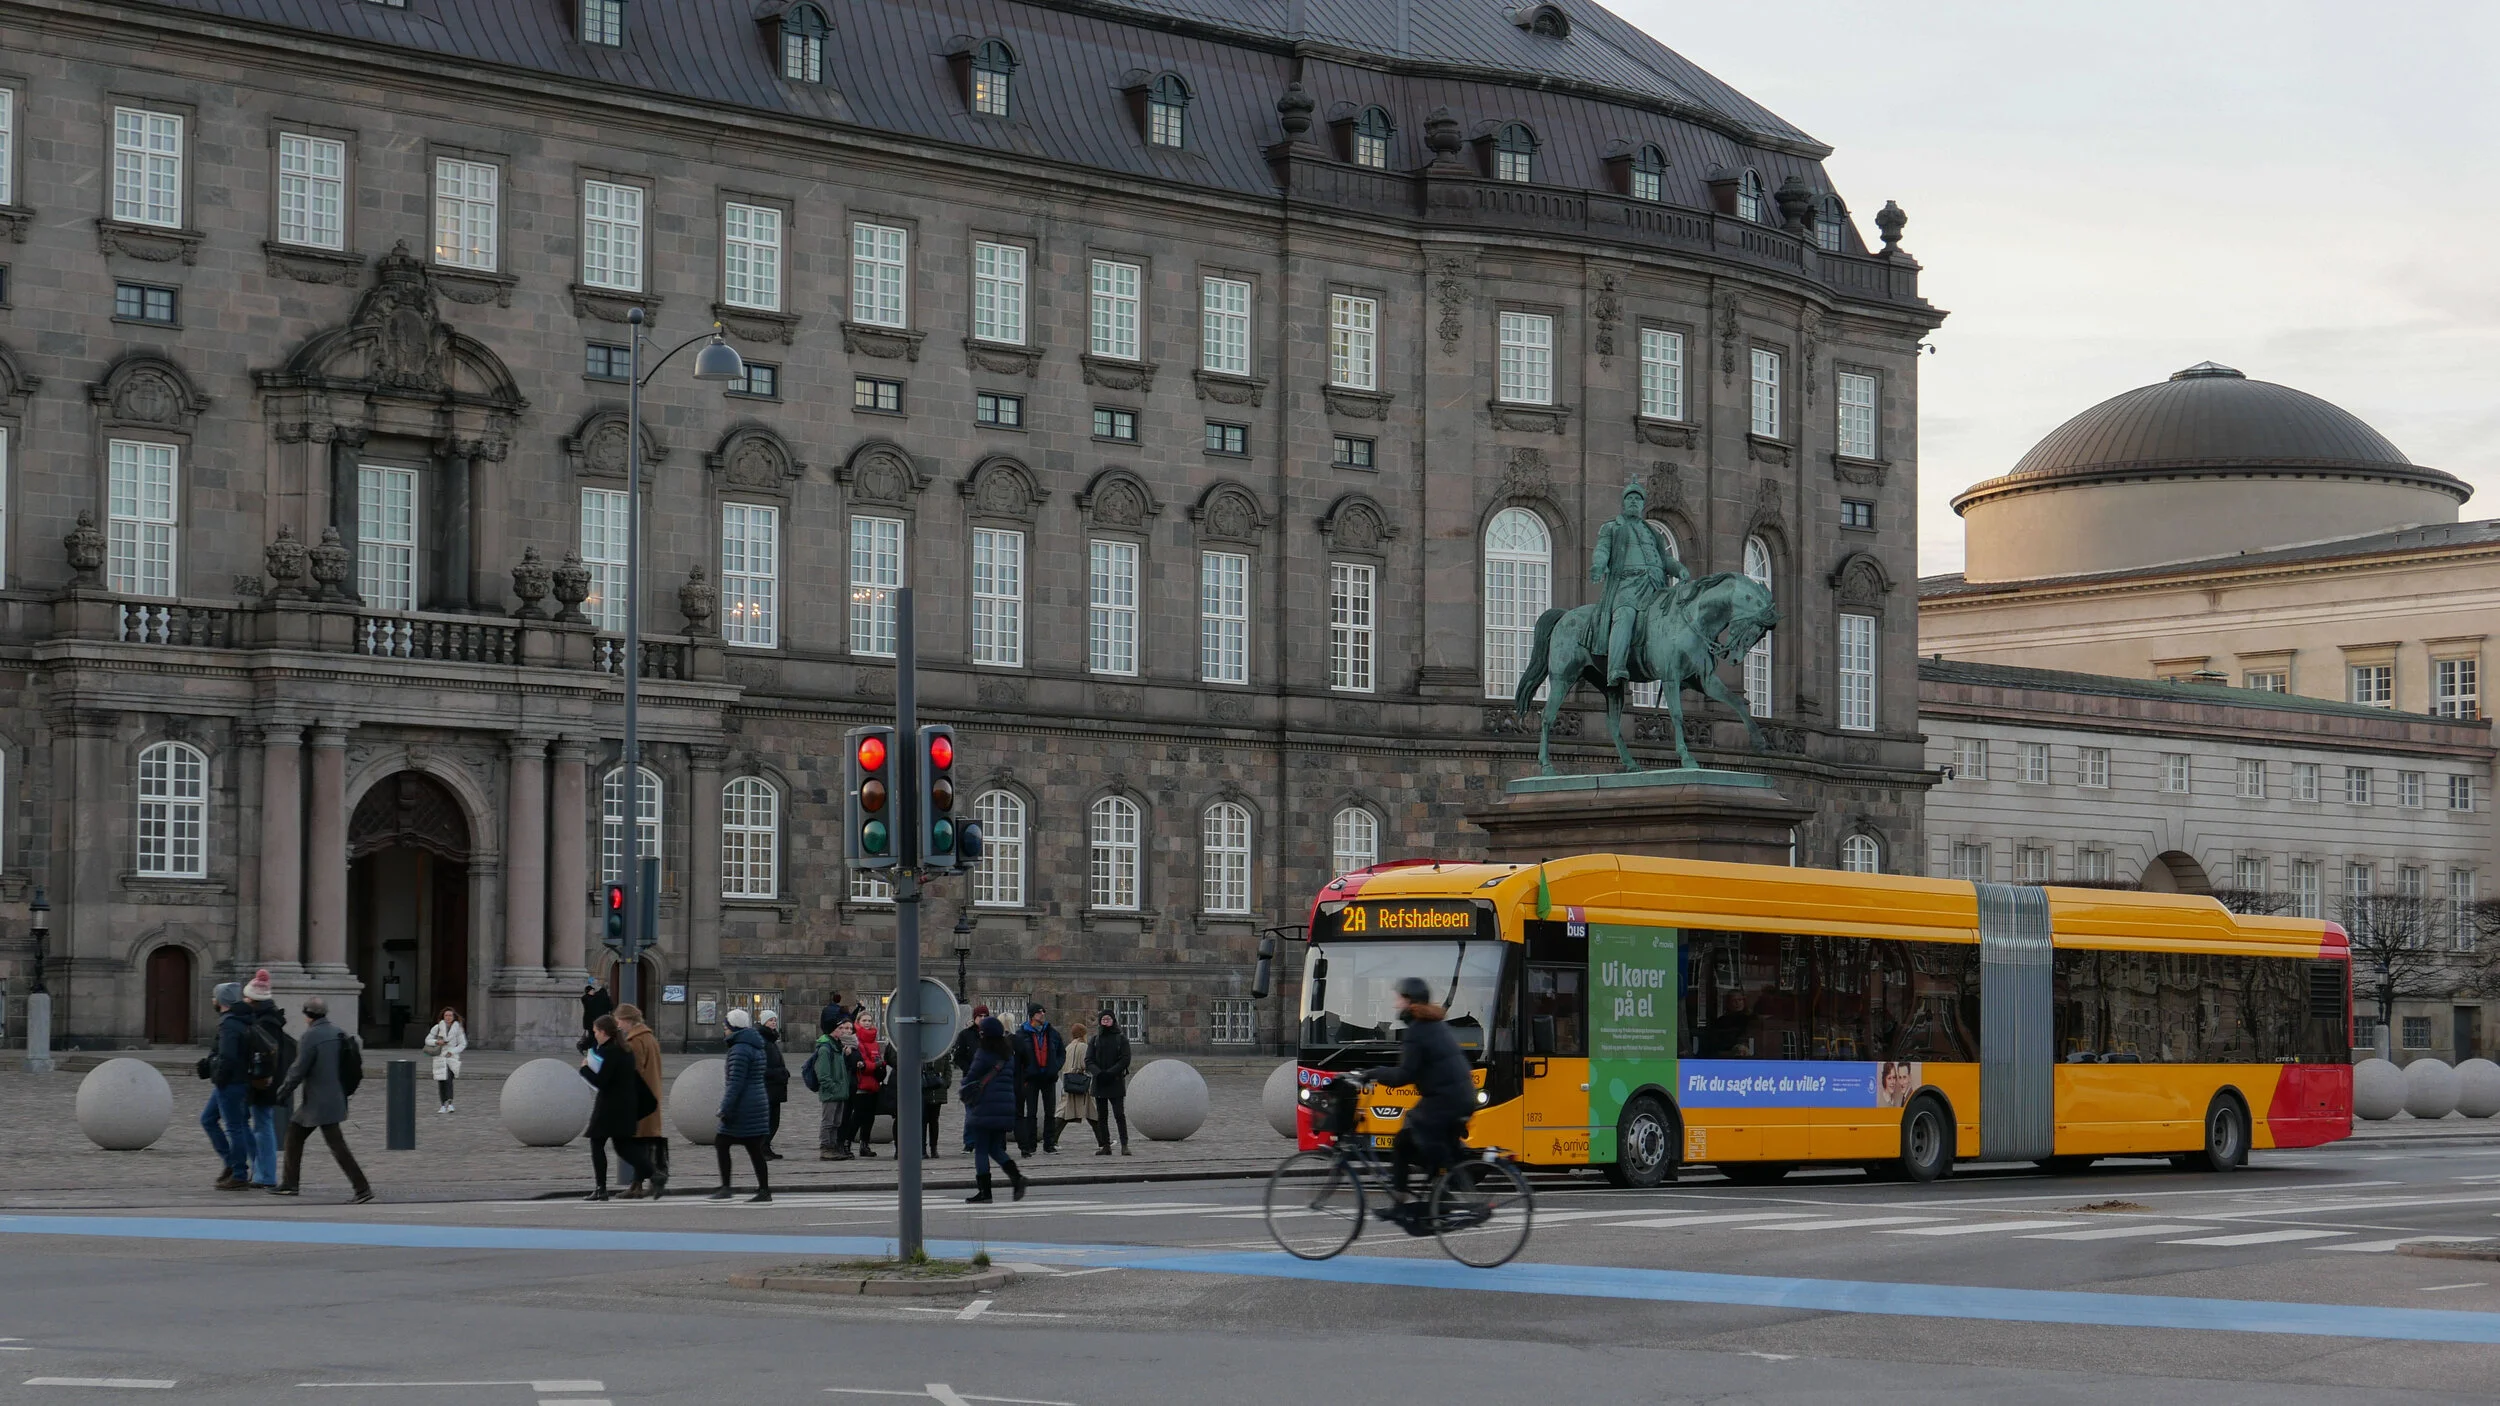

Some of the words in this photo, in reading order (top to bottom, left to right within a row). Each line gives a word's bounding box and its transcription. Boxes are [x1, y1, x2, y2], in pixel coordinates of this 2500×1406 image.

[1343, 907, 1367, 932] 2A
[1379, 908, 1469, 929] Refshaleøen
[1567, 907, 1576, 921] A
[1567, 922, 1586, 937] bus
[1622, 963, 1666, 988] kører
[1614, 990, 1634, 1022] på
[1637, 993, 1654, 1018] el
[1688, 1075, 1708, 1092] Fik
[1709, 1076, 1725, 1092] du
[1726, 1076, 1752, 1097] sagt
[1753, 1076, 1777, 1095] det,
[1779, 1076, 1795, 1092] du
[1796, 1075, 1827, 1092] ville?
[1376, 1107, 1399, 1115] VDL
[1526, 1112, 1543, 1123] 1873
[1375, 1137, 1386, 1146] CN
[1563, 1139, 1590, 1152] arriva
